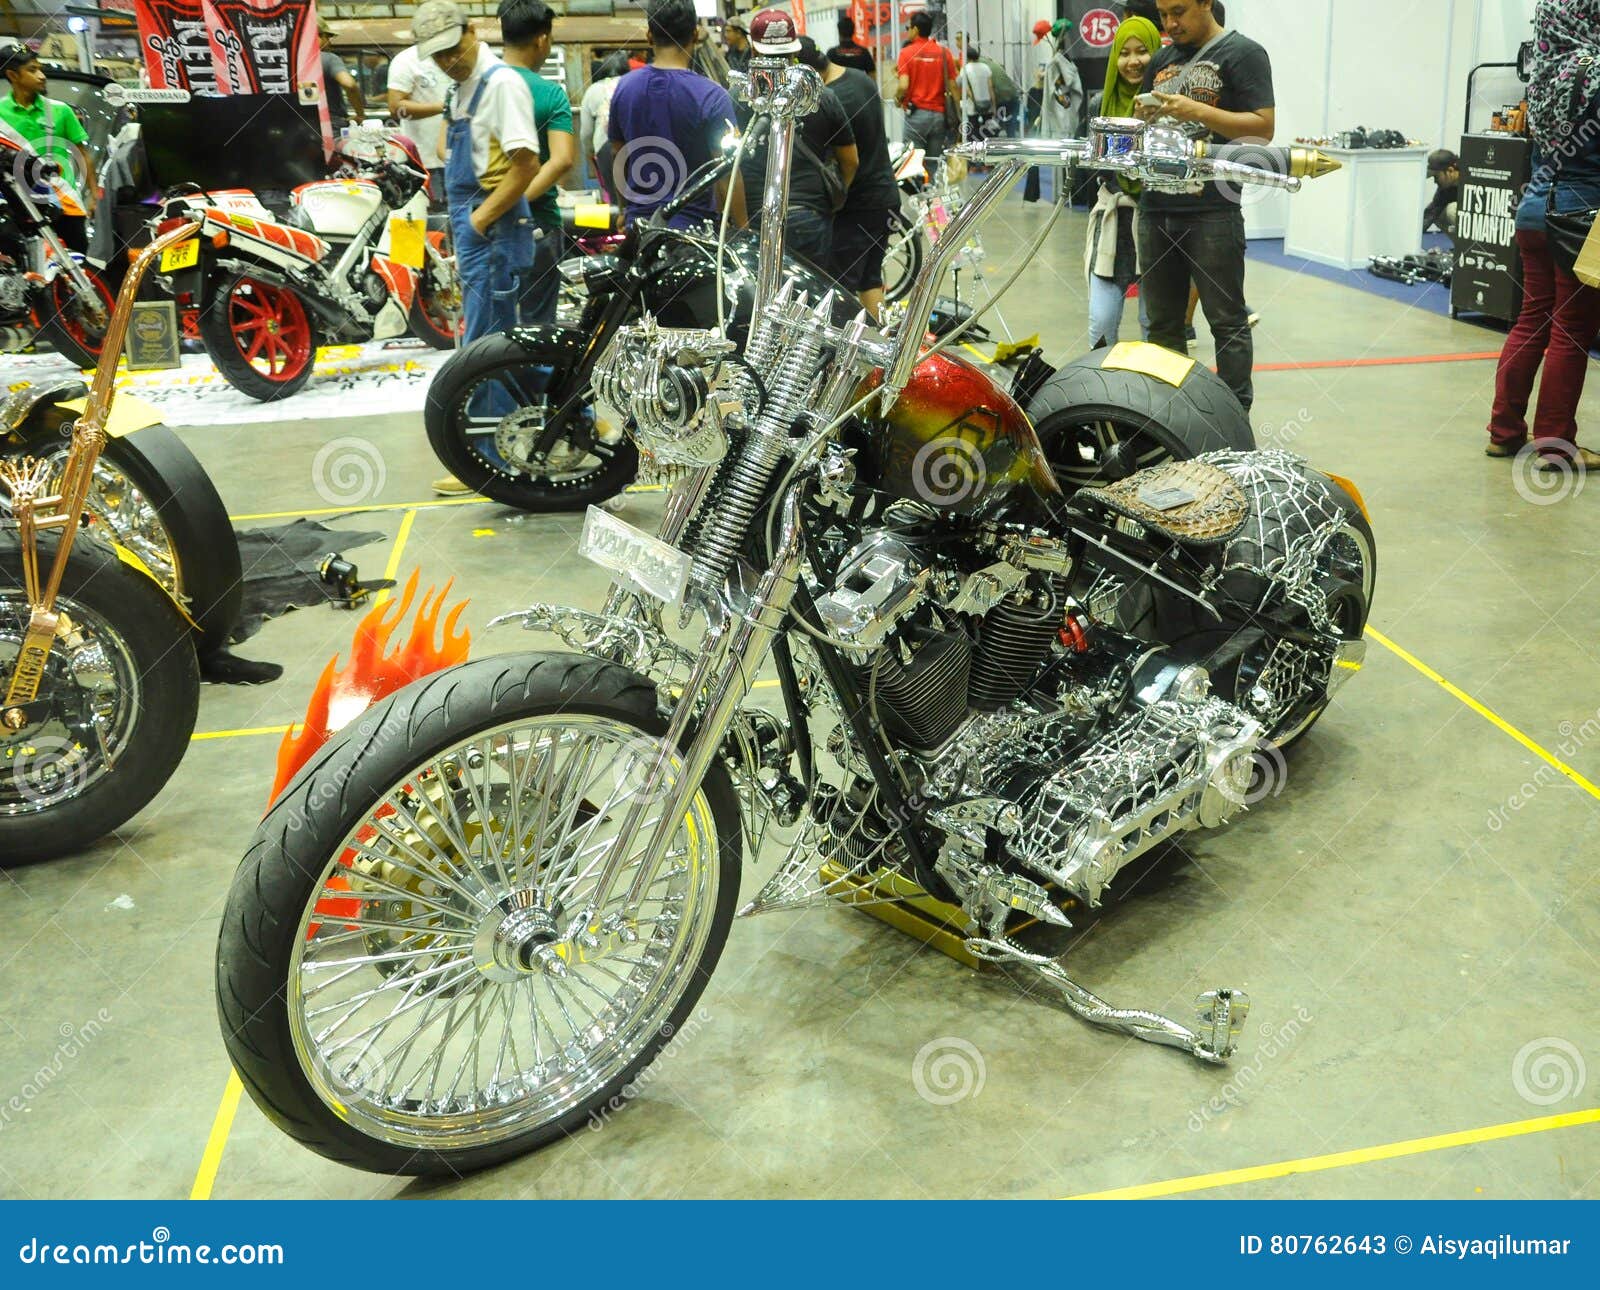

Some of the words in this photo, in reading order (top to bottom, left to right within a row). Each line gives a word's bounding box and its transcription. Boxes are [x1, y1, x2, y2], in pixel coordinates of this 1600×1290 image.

[1090, 17, 1112, 42] 15
[1462, 183, 1484, 214] IT'S
[1484, 186, 1514, 218] TIME
[1457, 211, 1472, 239] TO
[1471, 213, 1500, 245] MAN
[1499, 218, 1516, 248] UP
